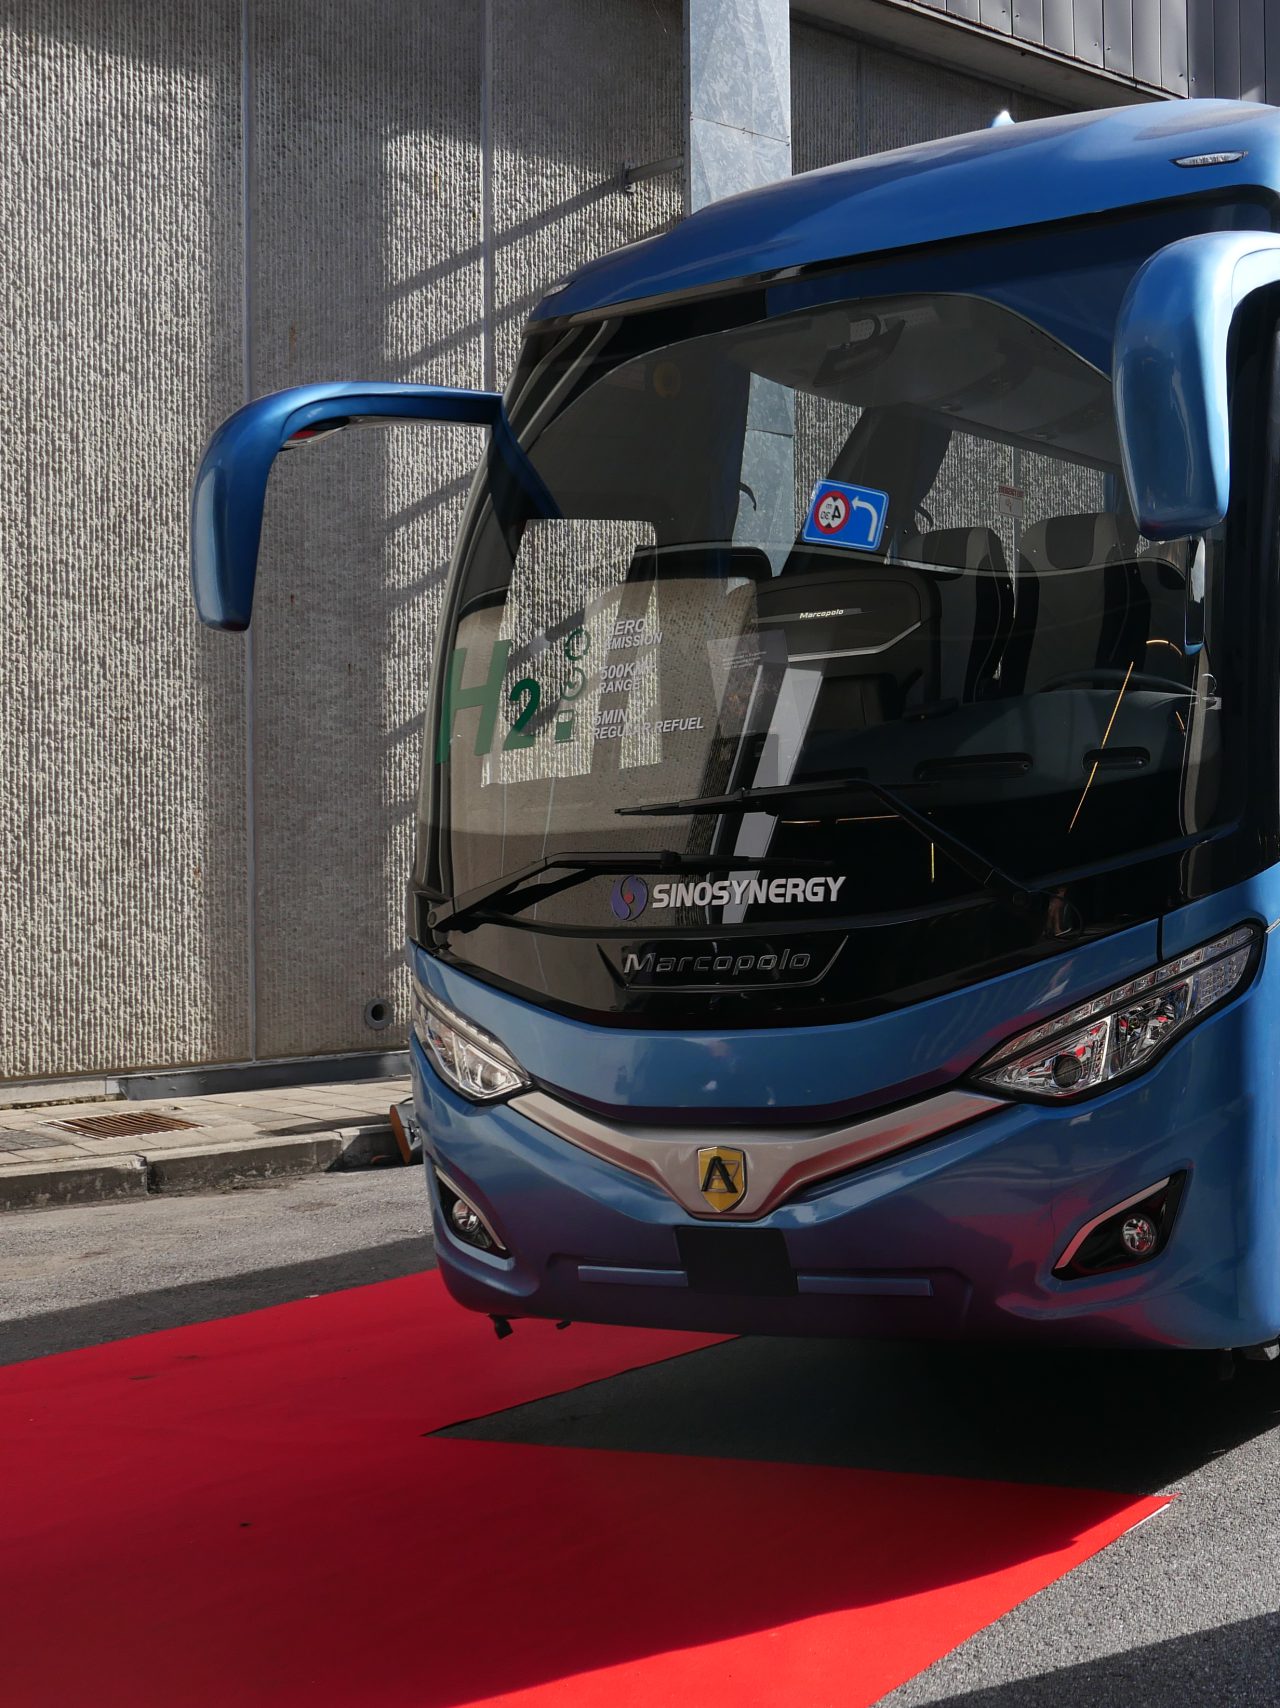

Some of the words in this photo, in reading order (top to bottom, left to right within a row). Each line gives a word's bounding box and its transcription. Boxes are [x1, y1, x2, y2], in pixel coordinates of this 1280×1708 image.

[799, 607, 844, 619] Marcopolo
[599, 678, 641, 694] RANGE
[655, 717, 705, 734] REFUEL
[652, 876, 846, 909] SINOSYNERGY
[623, 949, 811, 976] Marcopolo
